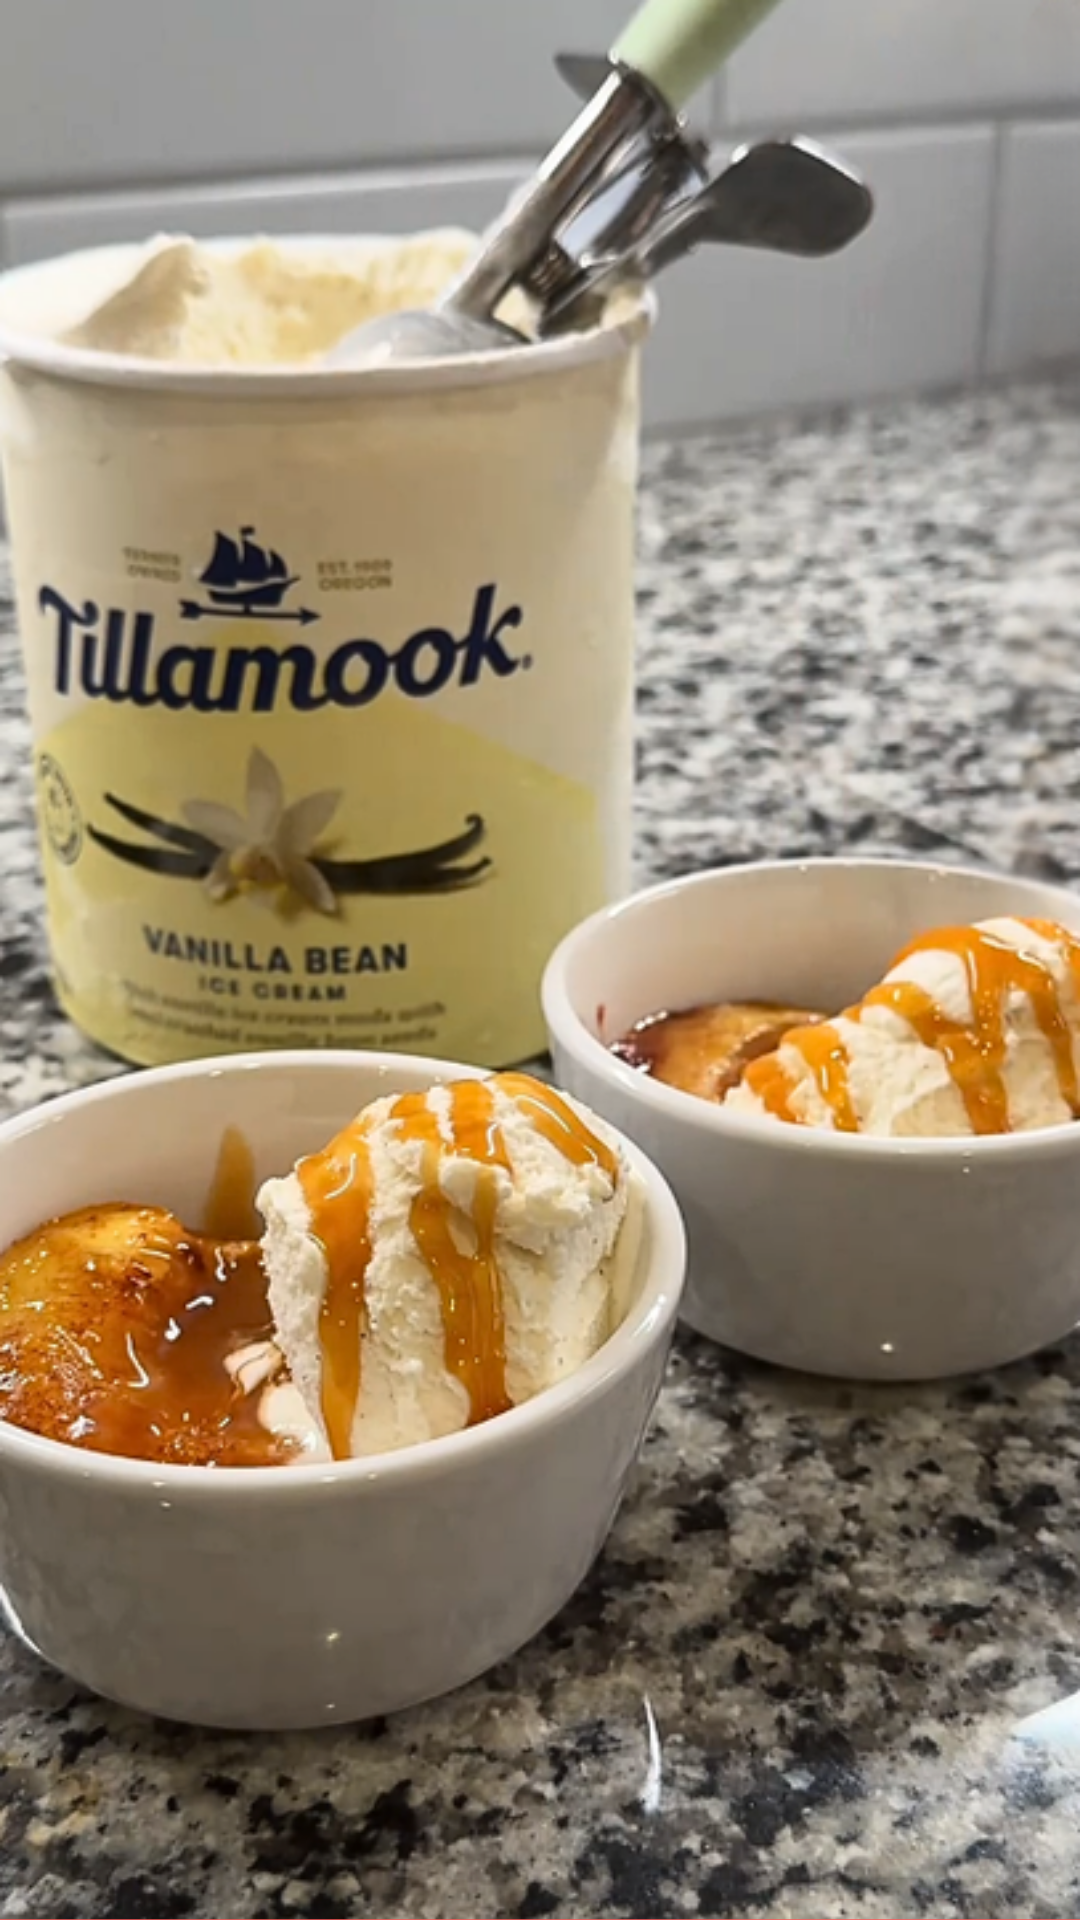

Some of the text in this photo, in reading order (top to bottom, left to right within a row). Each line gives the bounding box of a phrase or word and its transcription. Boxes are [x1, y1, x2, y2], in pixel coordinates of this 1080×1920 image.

[318, 575, 393, 593] OREGON
[142, 924, 407, 975] VANILLA BEAN
[198, 976, 346, 1001] ICE CREAM
